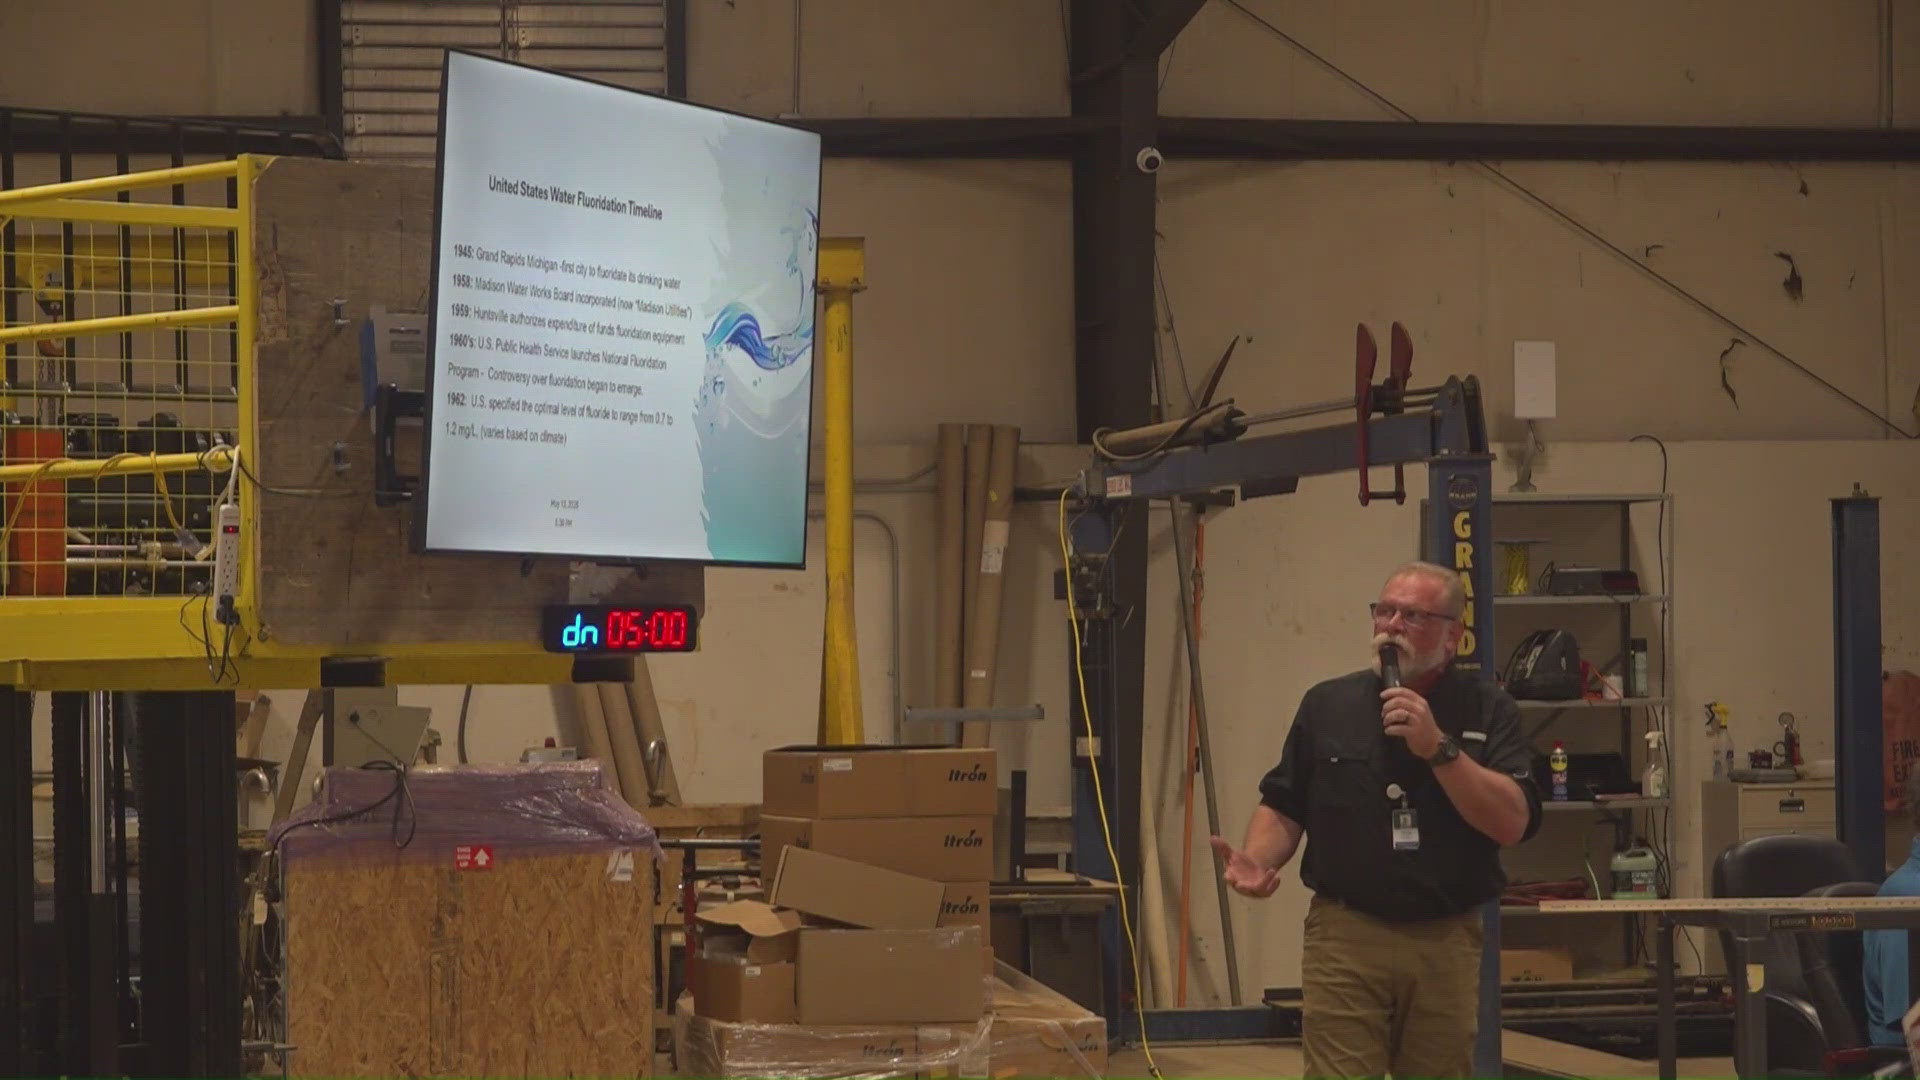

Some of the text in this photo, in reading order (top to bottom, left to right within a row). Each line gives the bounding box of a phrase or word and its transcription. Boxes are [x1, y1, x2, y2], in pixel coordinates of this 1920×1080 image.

[489, 174, 663, 221] United States Water Fluoridation Timeline
[454, 243, 474, 259] 1945:
[476, 246, 499, 263] Grand
[501, 250, 525, 268] Rapids
[527, 254, 558, 273] Michigan
[575, 264, 588, 279] city
[588, 265, 596, 277] to
[597, 265, 627, 282] fluoridate
[628, 270, 636, 283] its
[637, 271, 662, 290] drinking
[663, 277, 681, 289] water
[452, 273, 473, 289] 1958:
[475, 276, 505, 293] Madison
[507, 281, 528, 296] Water
[530, 284, 552, 299] Works
[553, 287, 574, 303] Board
[575, 291, 616, 308] incorporated
[451, 303, 472, 318] 1959:
[473, 306, 508, 322] Huntsville
[510, 312, 546, 328] authorizes
[547, 318, 587, 332] expenditure
[588, 321, 596, 334] of
[596, 322, 615, 336] funds
[616, 324, 651, 340] fluoridation
[478, 336, 494, 351] U.S.
[495, 337, 517, 353] Public
[519, 340, 542, 356] Health
[543, 343, 569, 359] Service
[570, 347, 600, 362] launches
[602, 350, 628, 366] National
[630, 353, 667, 370] Fluoridation
[447, 361, 480, 380] Program
[487, 366, 531, 386] Controversy
[531, 374, 548, 386] over
[549, 373, 586, 389] fluoridation
[587, 378, 608, 395] began
[609, 380, 616, 393] to
[471, 394, 487, 409] U.S.
[488, 396, 520, 412] specified
[521, 399, 533, 412] the
[534, 402, 559, 416] optimal
[561, 403, 577, 416] level
[577, 404, 586, 417] of
[586, 405, 610, 420] fluoride
[611, 409, 619, 421] to
[619, 410, 638, 425] range
[639, 410, 654, 424] from
[666, 413, 674, 426] to
[480, 425, 505, 440] (varies
[506, 427, 528, 441] based
[529, 431, 538, 442] on
[540, 429, 567, 446] climate)
[1453, 511, 1476, 656] GRAND
[562, 610, 688, 649] dn 05:00
